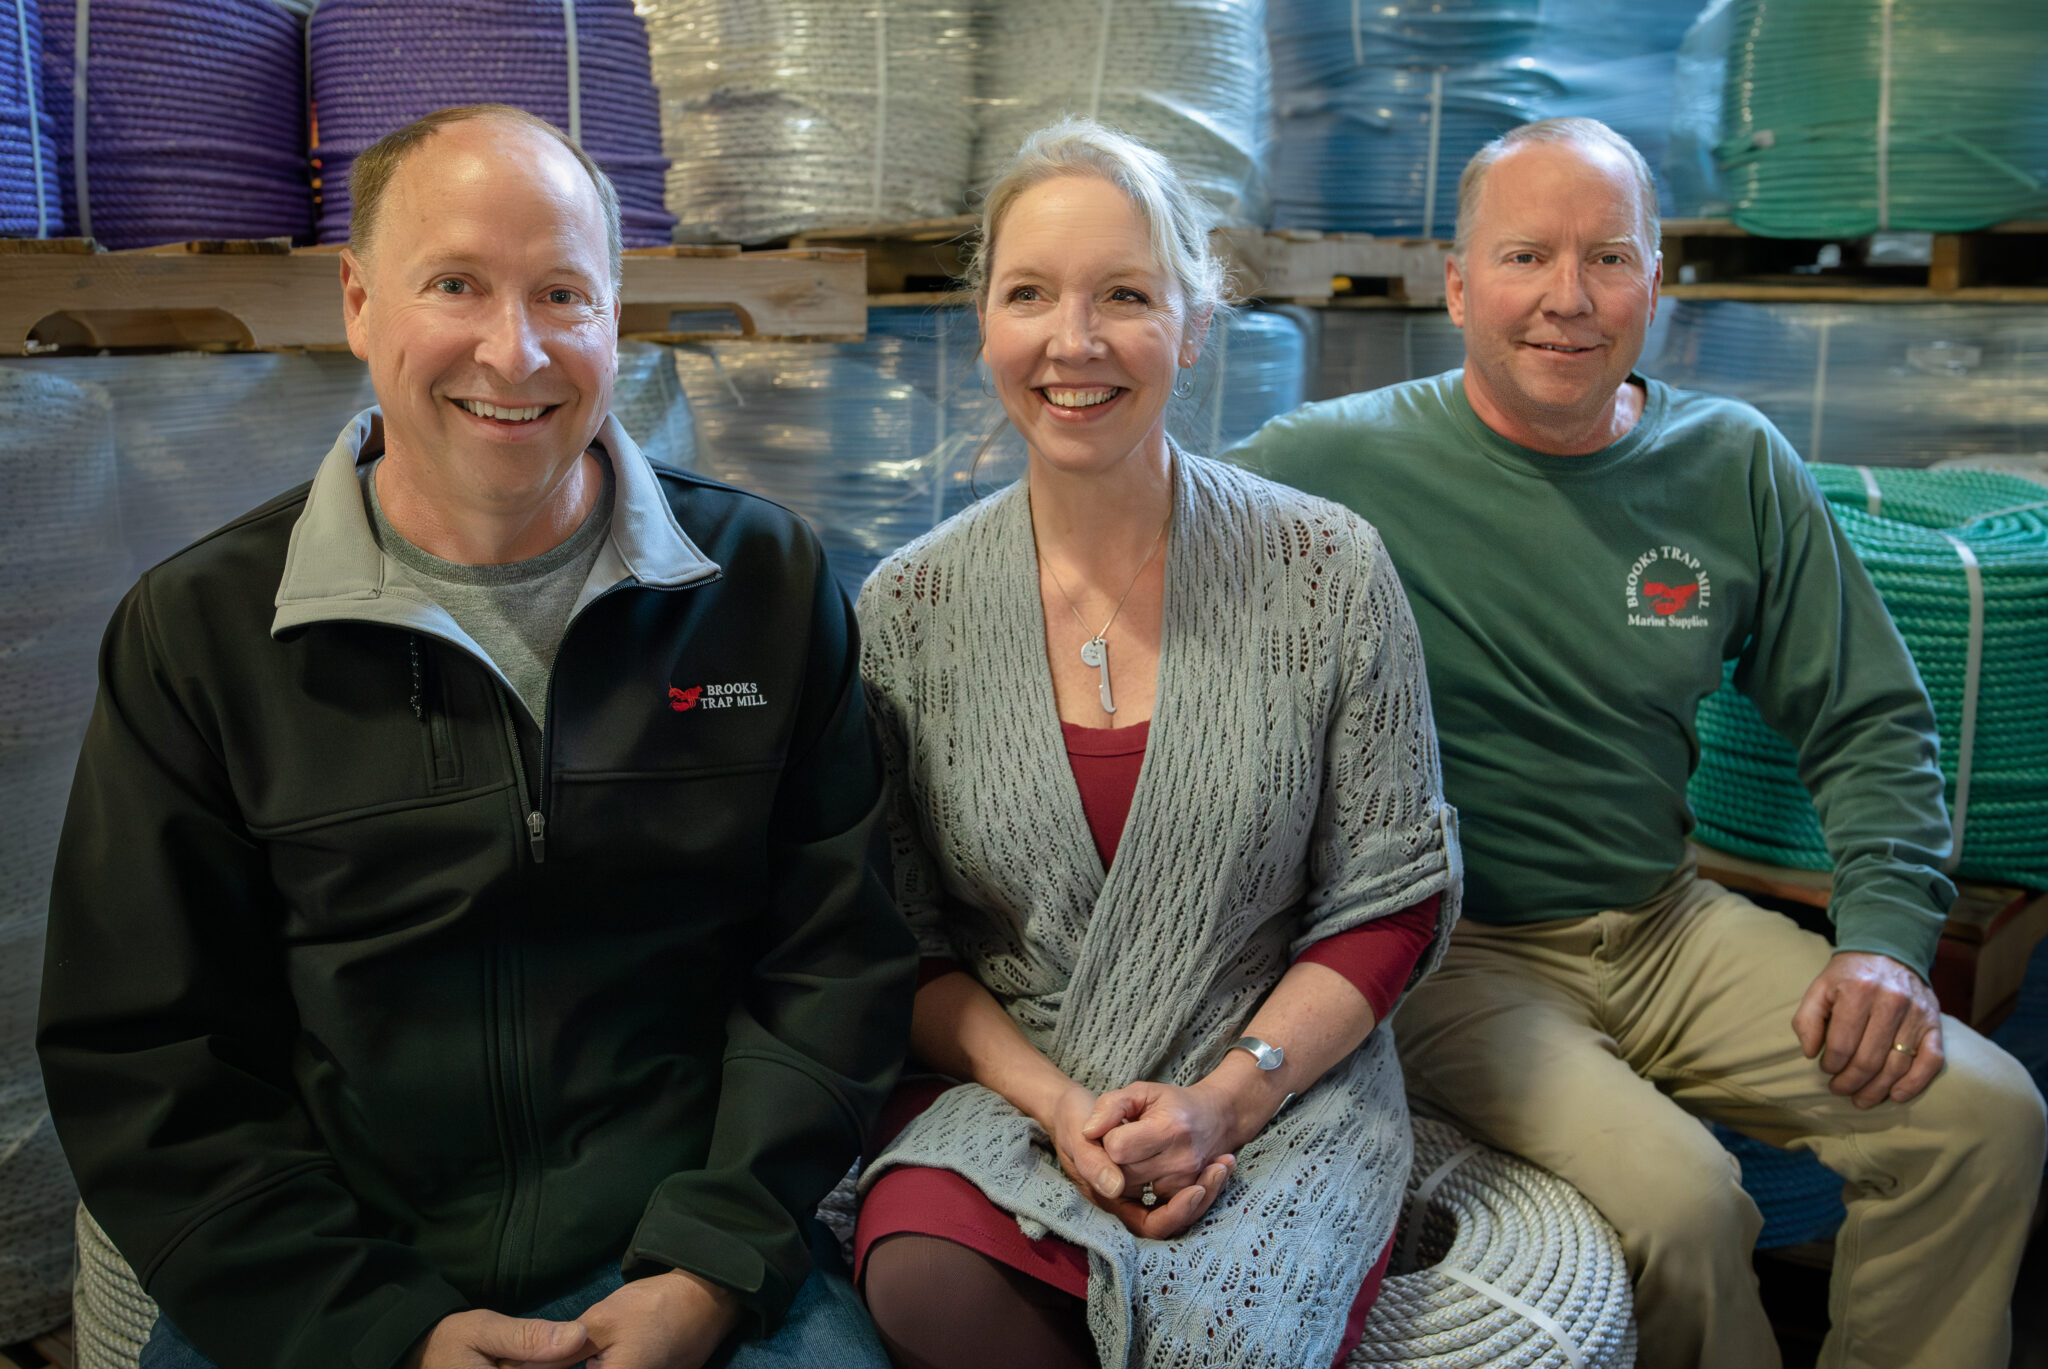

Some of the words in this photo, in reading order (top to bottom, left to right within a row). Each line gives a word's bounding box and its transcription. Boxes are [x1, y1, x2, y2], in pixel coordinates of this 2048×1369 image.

[1626, 548, 1658, 608] BROOKS
[1661, 546, 1701, 569] TRAP
[1696, 570, 1711, 609] MILL
[1628, 613, 1666, 627] Marine
[1668, 614, 1708, 629] Supplies
[707, 683, 758, 696] BROOKS
[700, 697, 733, 709] TRAP
[737, 694, 767, 707] MILL
